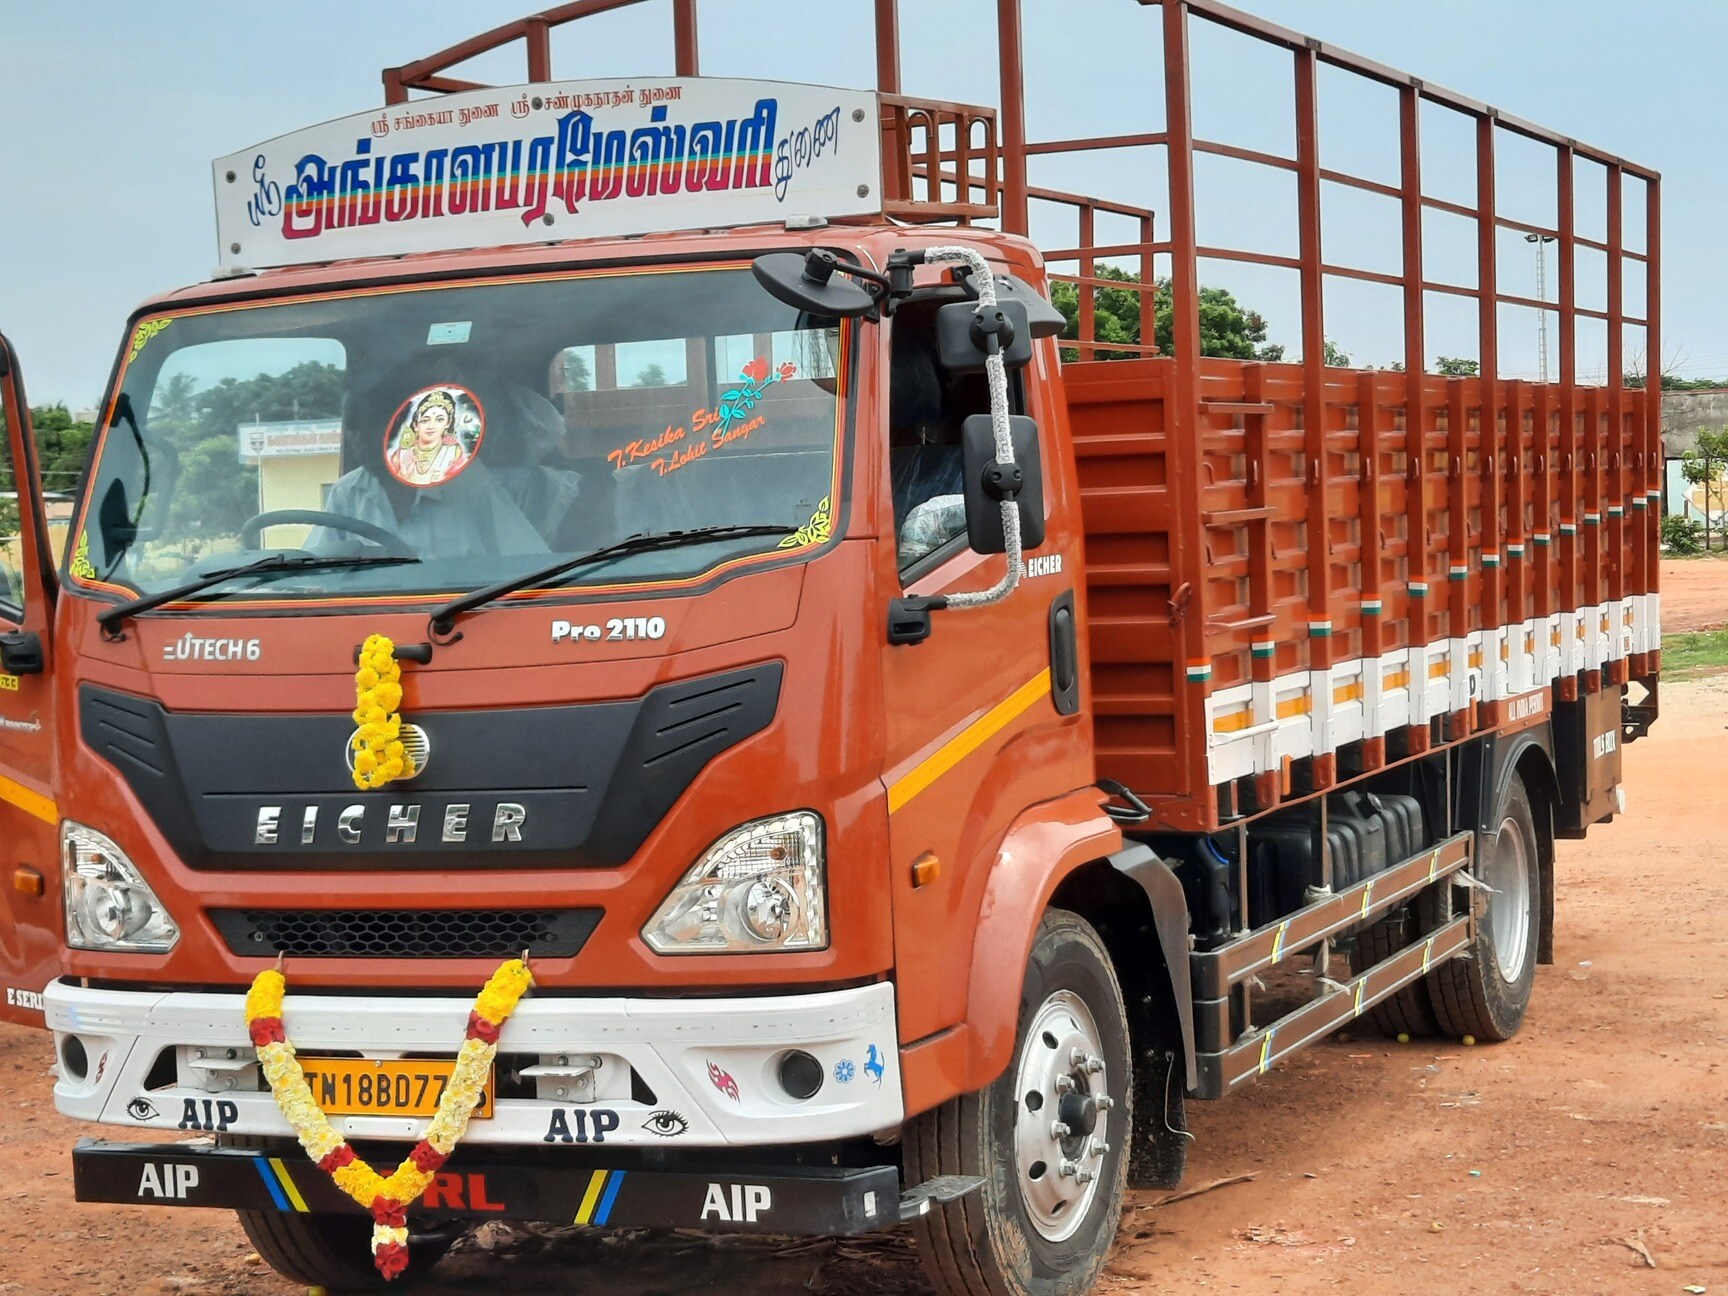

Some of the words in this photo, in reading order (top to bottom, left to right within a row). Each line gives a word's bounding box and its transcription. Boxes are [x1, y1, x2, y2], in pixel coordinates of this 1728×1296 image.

[638, 85, 683, 108] துணை
[458, 103, 500, 128] துணை
[774, 105, 841, 203] துணை
[1028, 554, 1062, 577] EICHER
[551, 620, 601, 642] Pro
[605, 616, 666, 641] 2110
[254, 803, 527, 845] EICHER
[303, 1071, 487, 1109] TN18BD77
[178, 1098, 238, 1132] AIP
[544, 1108, 620, 1143] AIP
[138, 1162, 200, 1199] AIP
[700, 1183, 772, 1223] AIP
